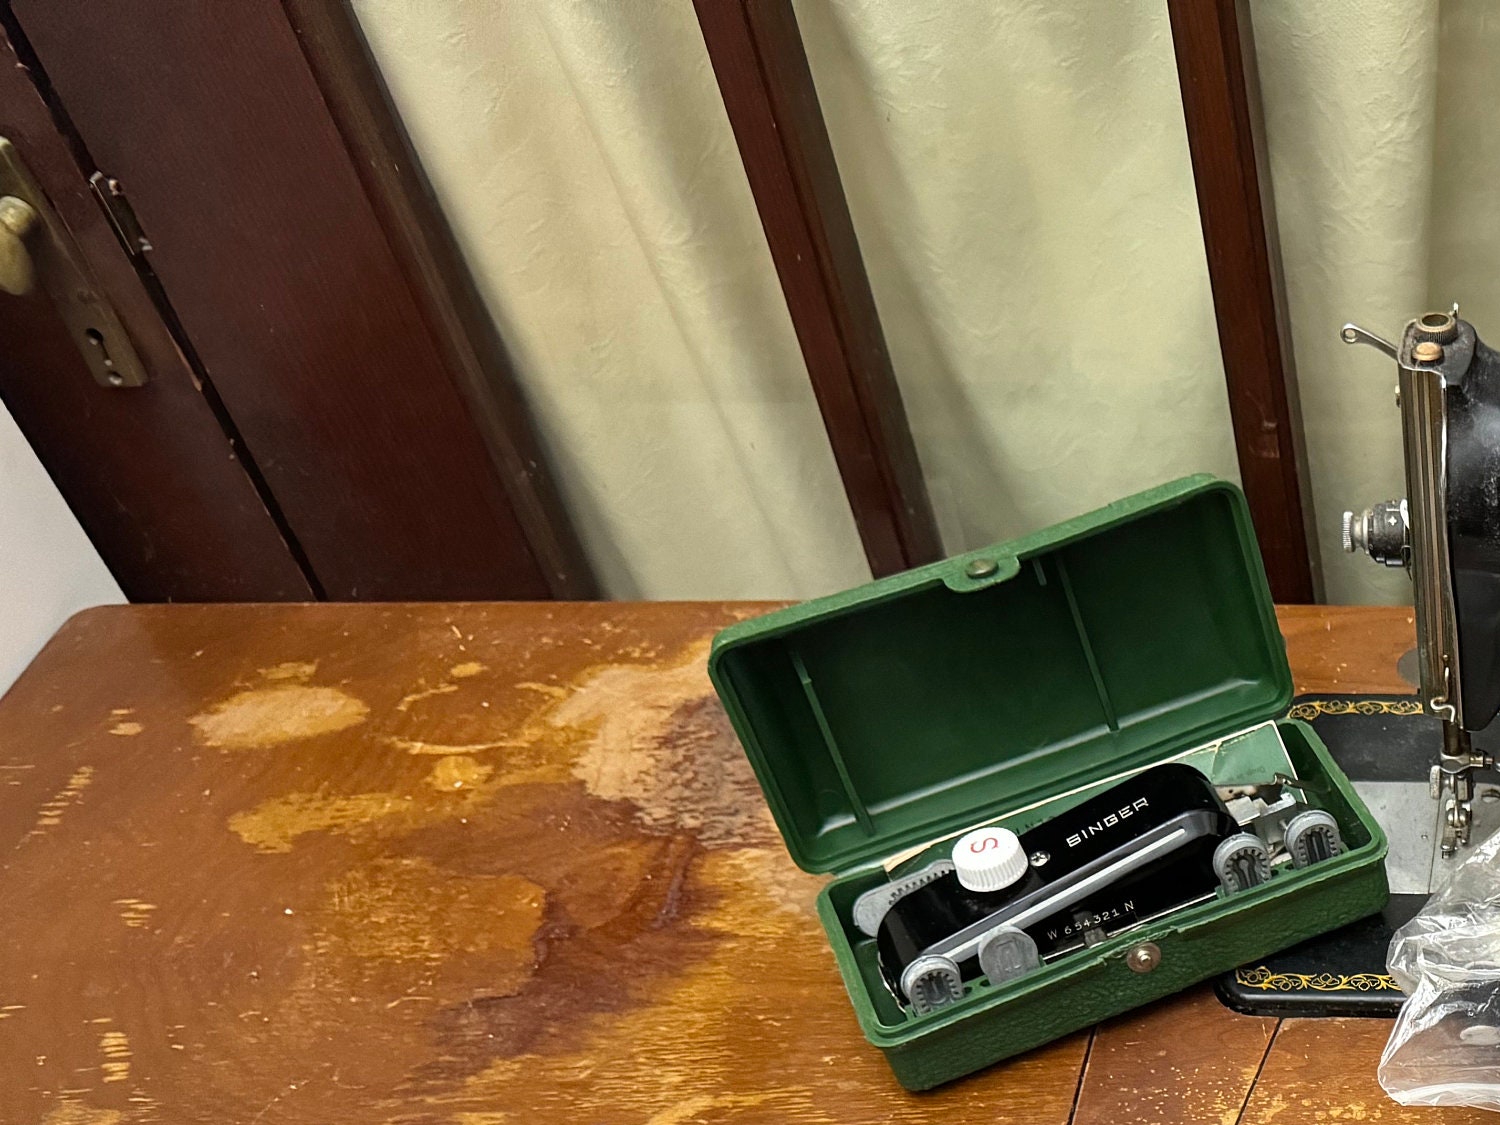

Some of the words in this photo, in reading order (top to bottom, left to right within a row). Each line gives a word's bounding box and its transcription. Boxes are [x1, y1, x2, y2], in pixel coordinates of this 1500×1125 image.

[1066, 797, 1149, 848] SINGER
[1047, 929, 1058, 940] W
[1064, 908, 1120, 935] 654321
[1124, 900, 1135, 912] N
